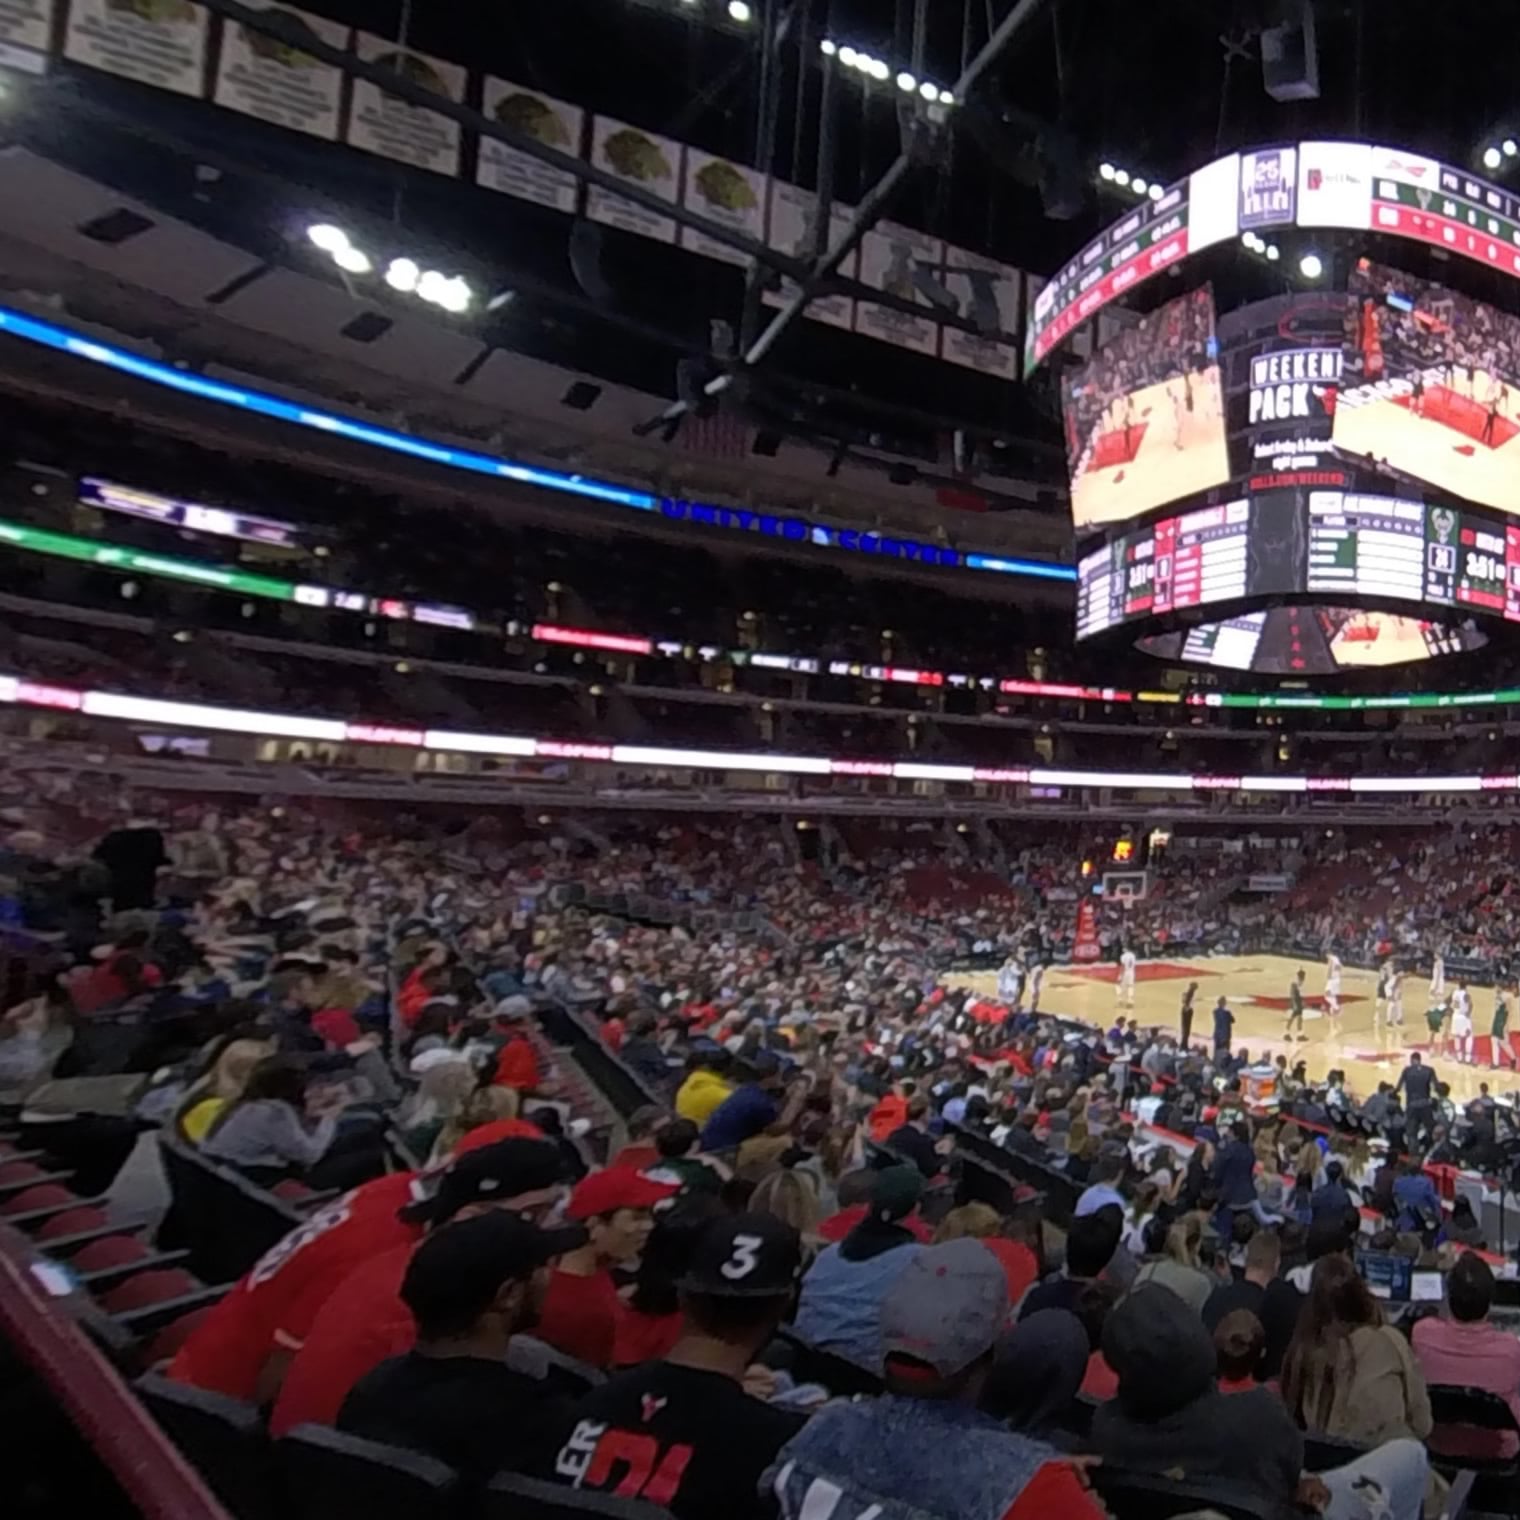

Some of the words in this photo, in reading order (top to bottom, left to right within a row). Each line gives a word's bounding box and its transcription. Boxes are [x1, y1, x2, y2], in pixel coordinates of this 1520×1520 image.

[1249, 383, 1309, 424] PACK
[660, 497, 807, 543] UNITED
[840, 527, 960, 568] CENTER
[720, 1233, 764, 1280] 3
